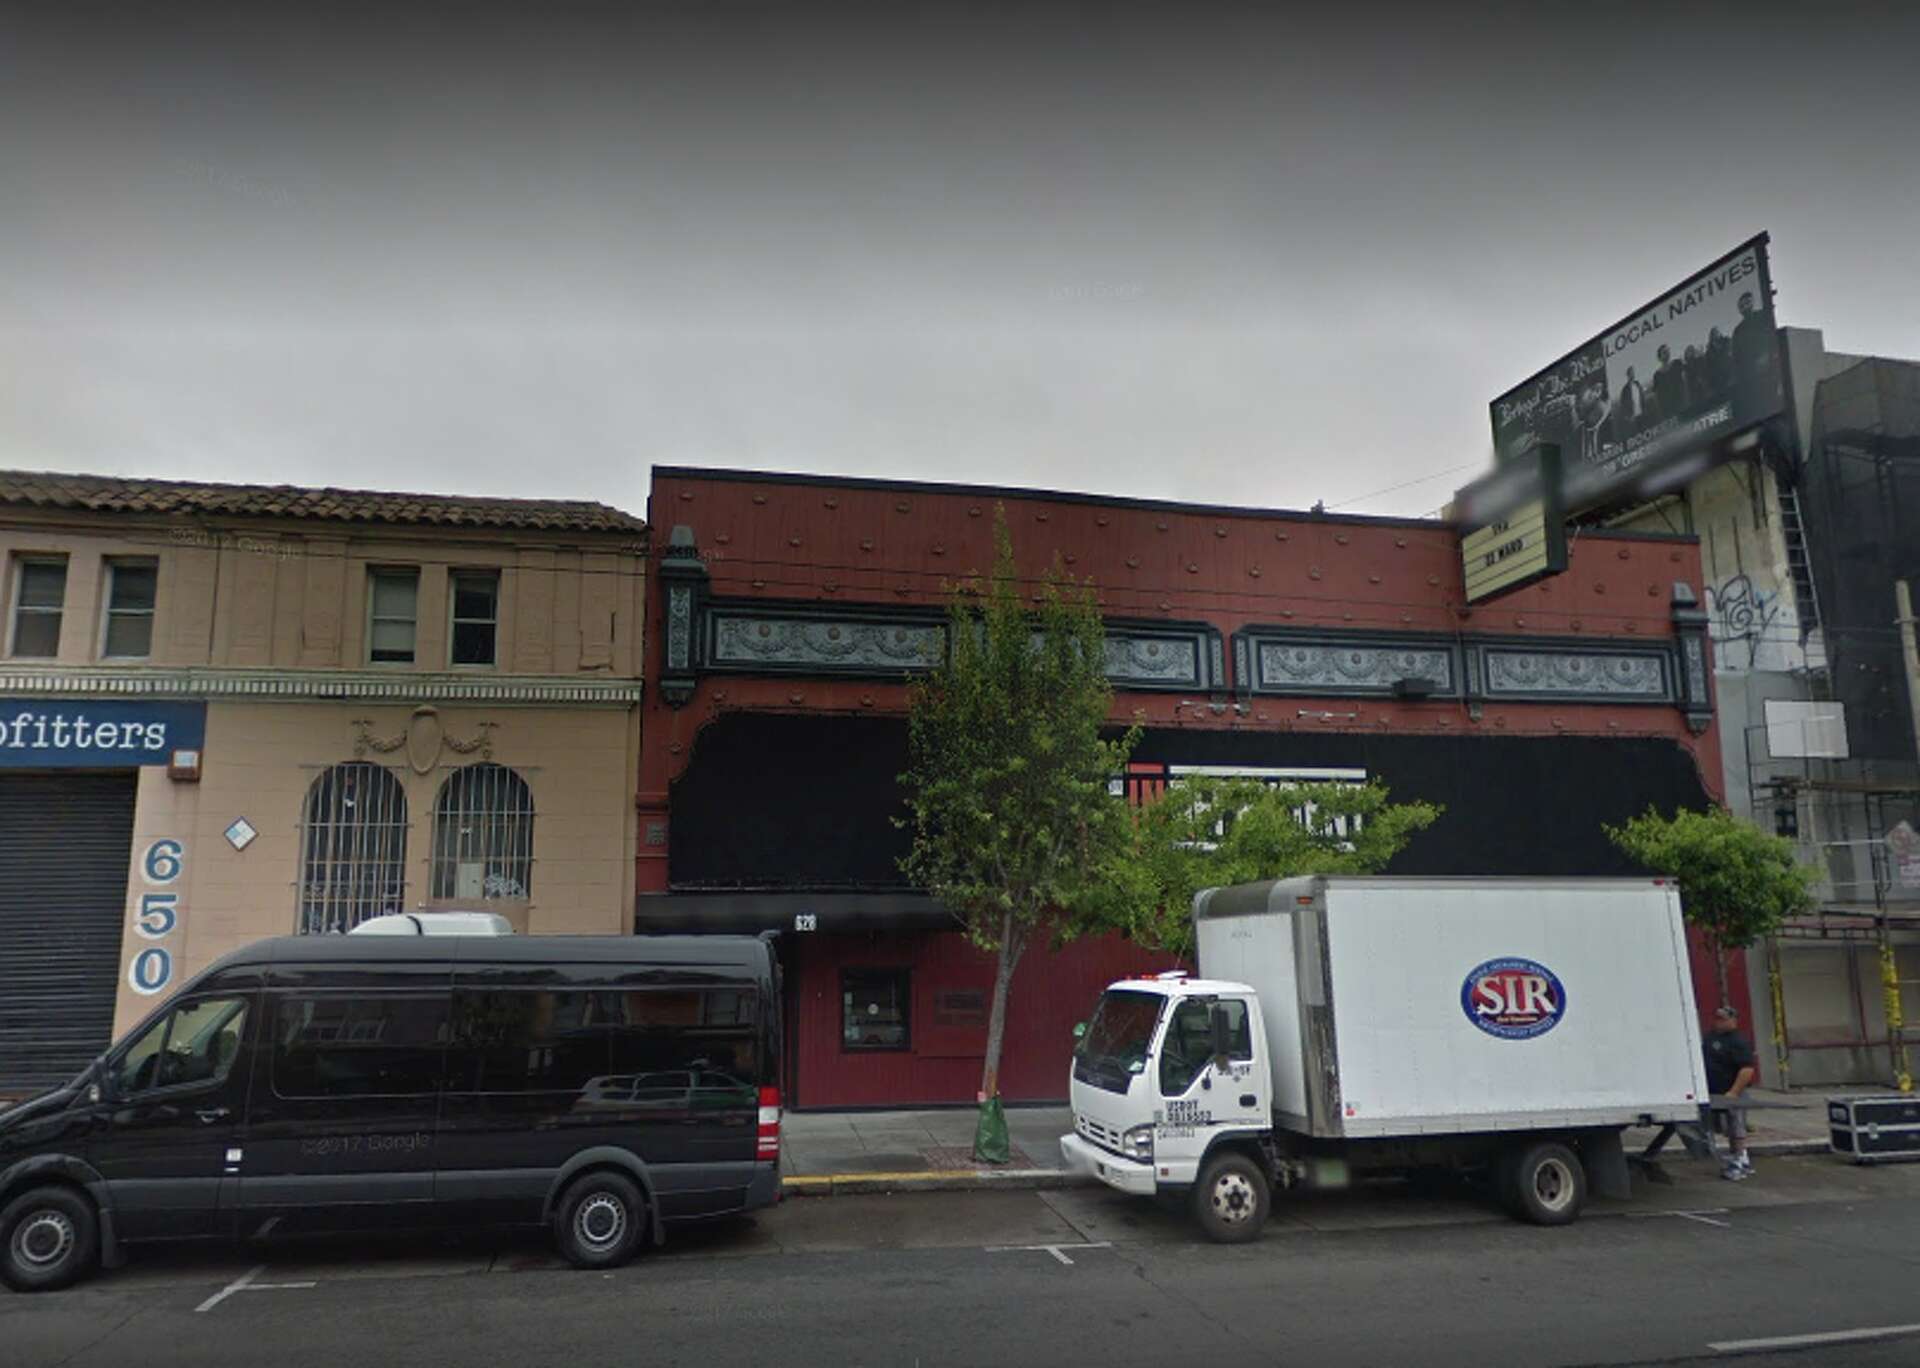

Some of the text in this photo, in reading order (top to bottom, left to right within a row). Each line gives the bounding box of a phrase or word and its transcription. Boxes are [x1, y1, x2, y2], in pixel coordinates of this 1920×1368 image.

[1604, 256, 1756, 358] LOCAL NATIVES
[129, 838, 183, 996] 650
[1477, 974, 1557, 1015] SIR
